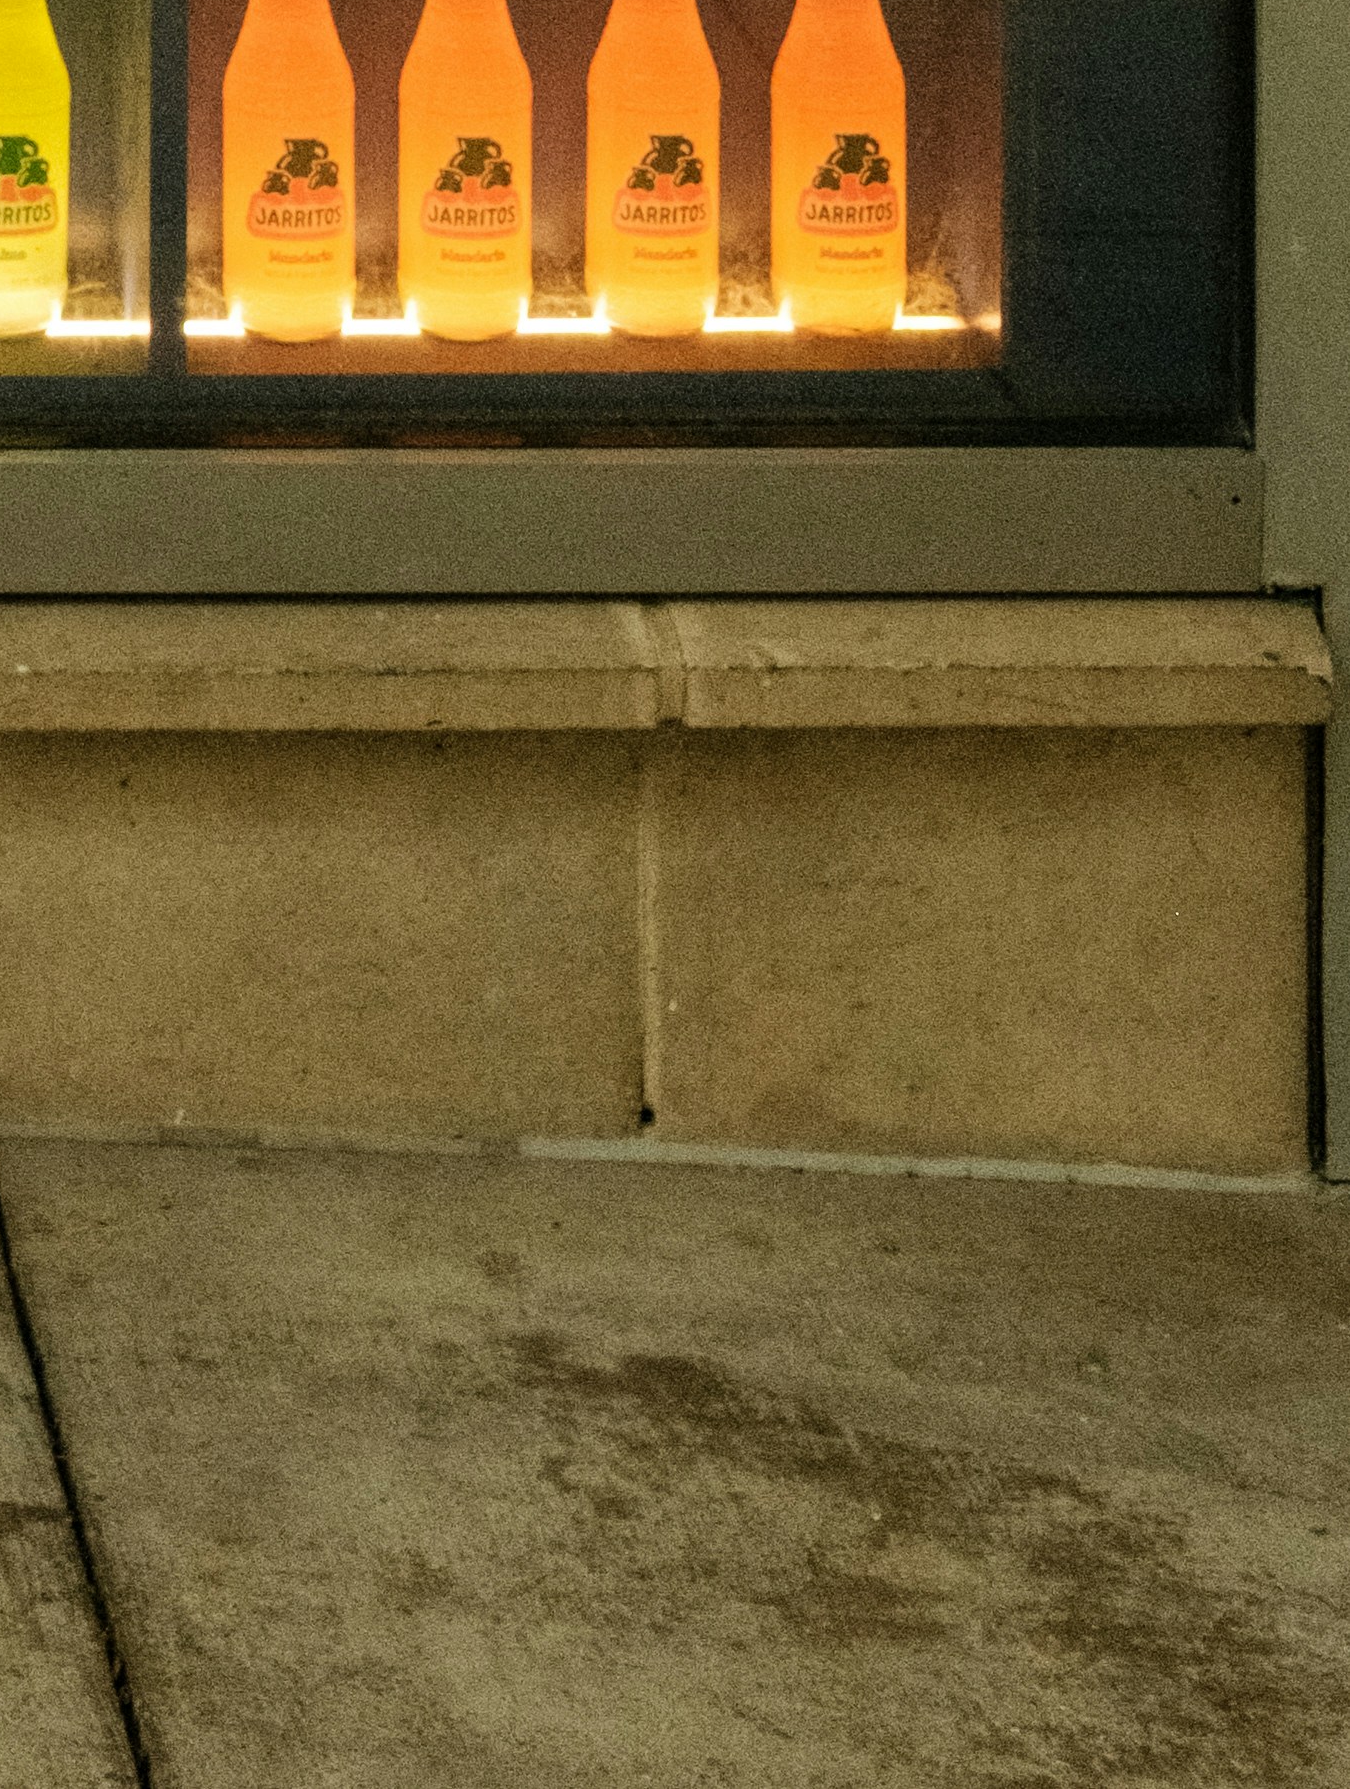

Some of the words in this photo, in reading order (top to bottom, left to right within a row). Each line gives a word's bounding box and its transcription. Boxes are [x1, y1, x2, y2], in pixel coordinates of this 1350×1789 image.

[256, 206, 341, 227] JARRITOS
[429, 205, 515, 226] JARRITOS
[621, 203, 706, 224] JARRITOS
[806, 202, 892, 223] JARRITOS
